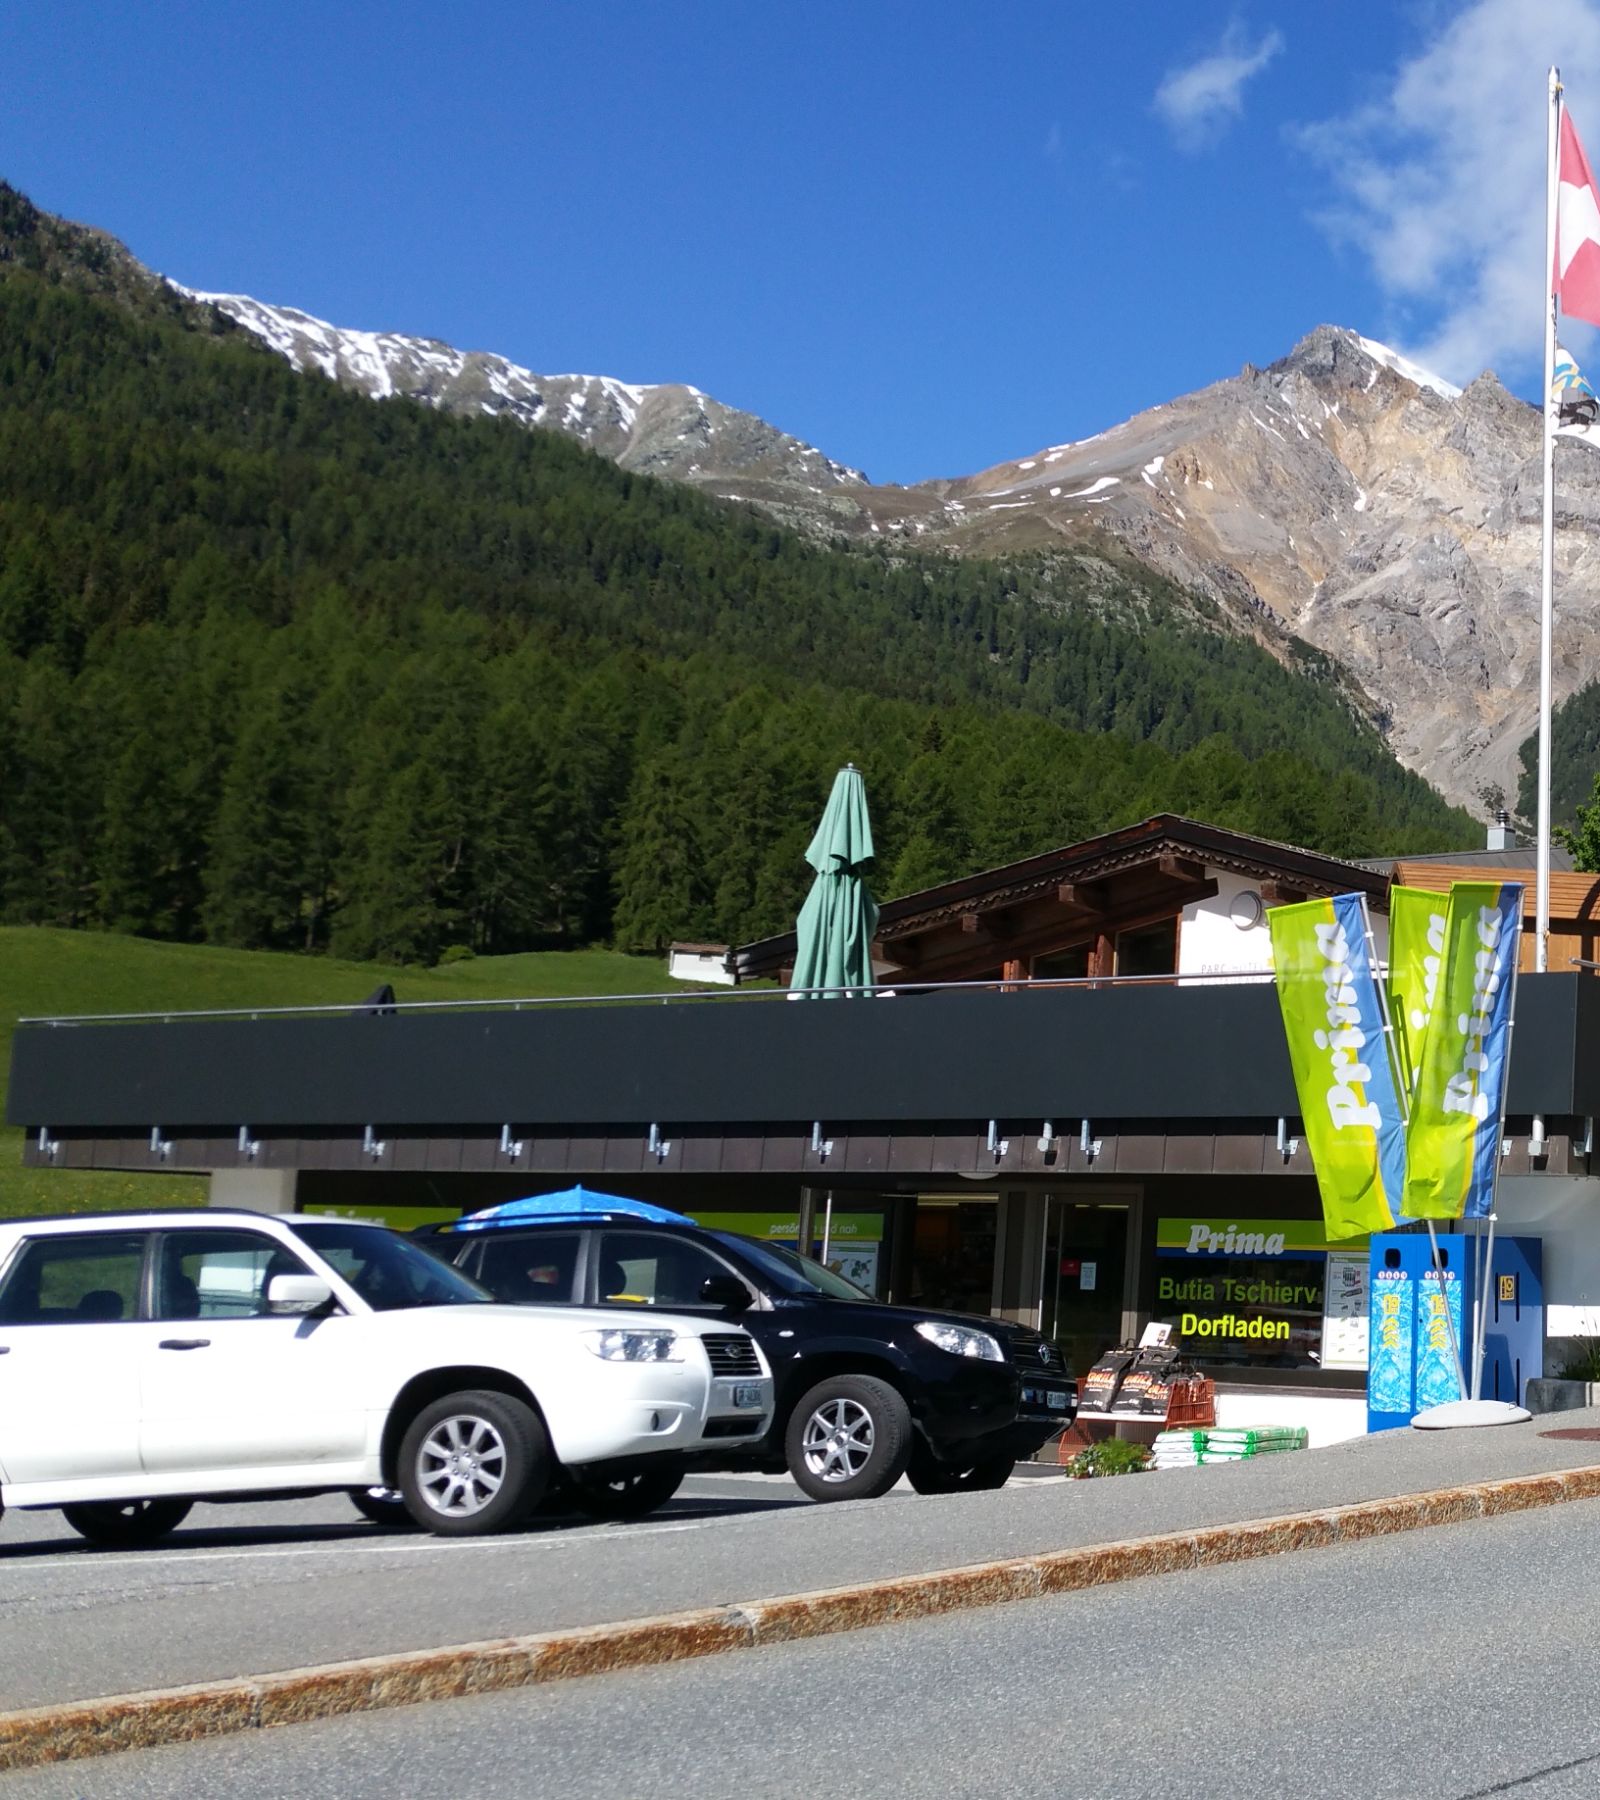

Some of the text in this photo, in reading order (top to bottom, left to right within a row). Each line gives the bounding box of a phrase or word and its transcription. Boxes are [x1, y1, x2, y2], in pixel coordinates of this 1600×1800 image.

[1313, 920, 1383, 1131] Prima
[1442, 904, 1503, 1122] Prima
[1185, 1223, 1286, 1256] Prima
[1159, 1277, 1318, 1304] Butia Tschierv
[1180, 1312, 1291, 1340] Dorfladen
